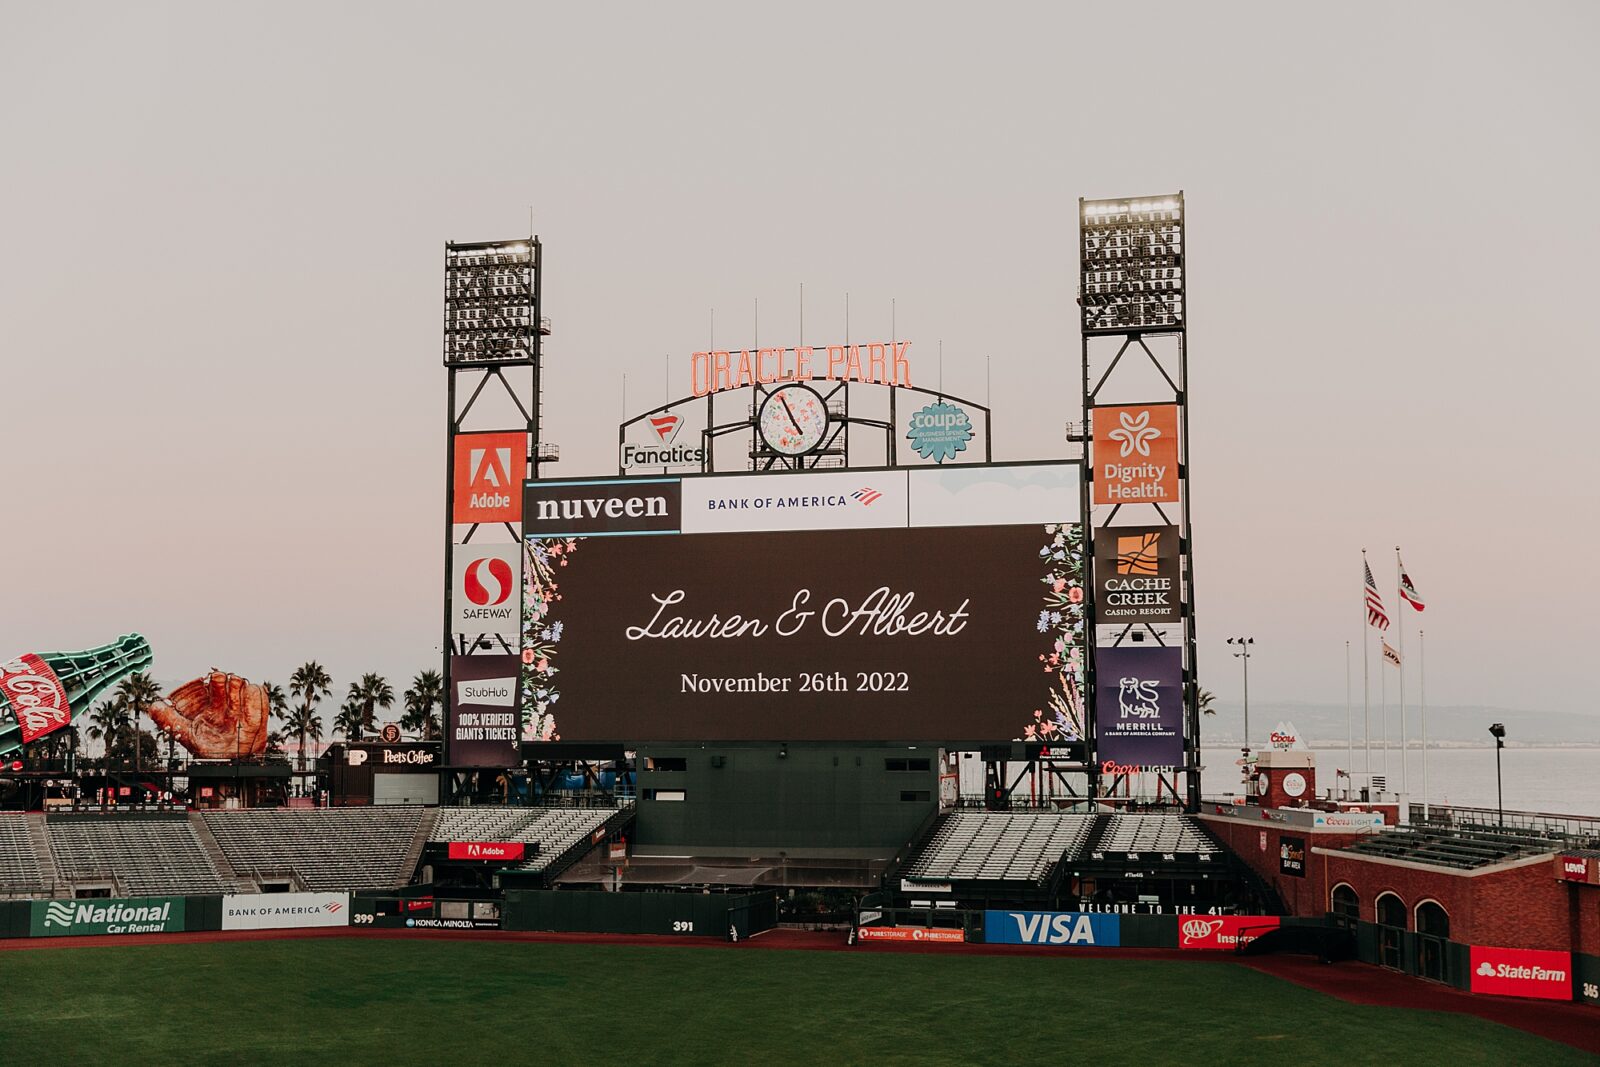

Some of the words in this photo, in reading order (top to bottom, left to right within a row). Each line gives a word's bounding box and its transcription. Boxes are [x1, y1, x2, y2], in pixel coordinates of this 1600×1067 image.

[691, 347, 813, 397] ORACLE
[825, 341, 912, 388] PARK
[915, 413, 966, 430] coupa
[624, 445, 704, 464] Fanatics
[1104, 462, 1166, 483] Dignity
[469, 493, 510, 508] Adobe
[537, 495, 668, 520] nuveen
[708, 499, 749, 510] BANK
[754, 498, 773, 509] OF
[776, 495, 847, 508] AMERICA
[1105, 577, 1171, 591] CACHE
[1107, 592, 1169, 606] CREEK
[463, 608, 512, 619] SAFEWAY
[626, 590, 769, 641] Lauren
[776, 589, 815, 637] &
[821, 586, 970, 637] Albert
[1105, 608, 1137, 616] CASINO
[1139, 607, 1171, 616] RESORT
[681, 673, 792, 693] November
[799, 672, 849, 692] 26th
[856, 672, 909, 692] 2022
[465, 687, 508, 697] StubHub
[459, 713, 480, 726] 100%
[481, 713, 514, 726] VERIFIED
[456, 728, 484, 741] GIANTS
[485, 727, 516, 740] TICKETS
[1116, 723, 1163, 731] MERRILL
[1271, 732, 1296, 743] Coors
[407, 750, 433, 765] Coffee
[1102, 760, 1140, 775] Coors
[1141, 765, 1175, 774] LIGHT
[1326, 816, 1350, 826] Coors
[1350, 818, 1372, 826] LIGHT
[1079, 903, 1136, 914] WELCOME
[1149, 905, 1162, 915] TO
[1175, 905, 1196, 915] THE
[1208, 906, 1226, 916] 41
[354, 913, 374, 924] 399
[415, 919, 442, 927] KONICA
[442, 920, 473, 928] MINOLTA
[107, 925, 125, 933] Car
[128, 923, 164, 933] Rental
[673, 921, 693, 931] 391
[1009, 913, 1095, 944] VISA
[1185, 921, 1210, 937] AAA
[1583, 983, 1599, 999] 365
